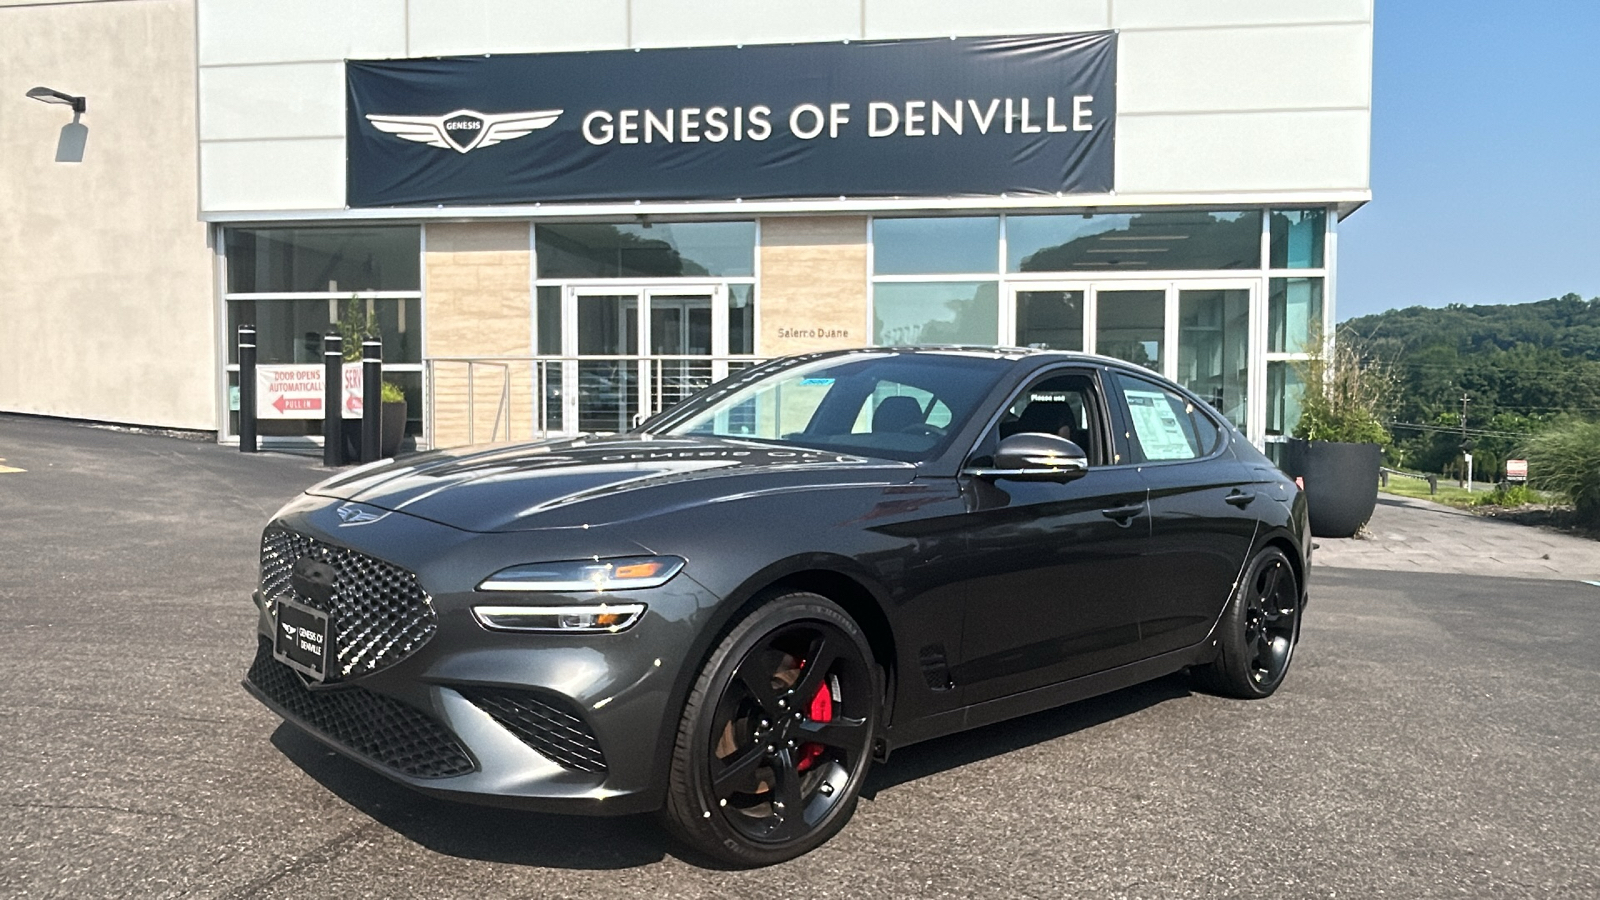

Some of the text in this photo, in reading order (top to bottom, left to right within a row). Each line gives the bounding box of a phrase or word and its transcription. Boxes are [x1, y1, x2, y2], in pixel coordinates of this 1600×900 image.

[446, 120, 481, 131] GENESIS
[582, 94, 1095, 146] GENESIS OF DENVILLE
[274, 370, 321, 381] DOOR OPENS
